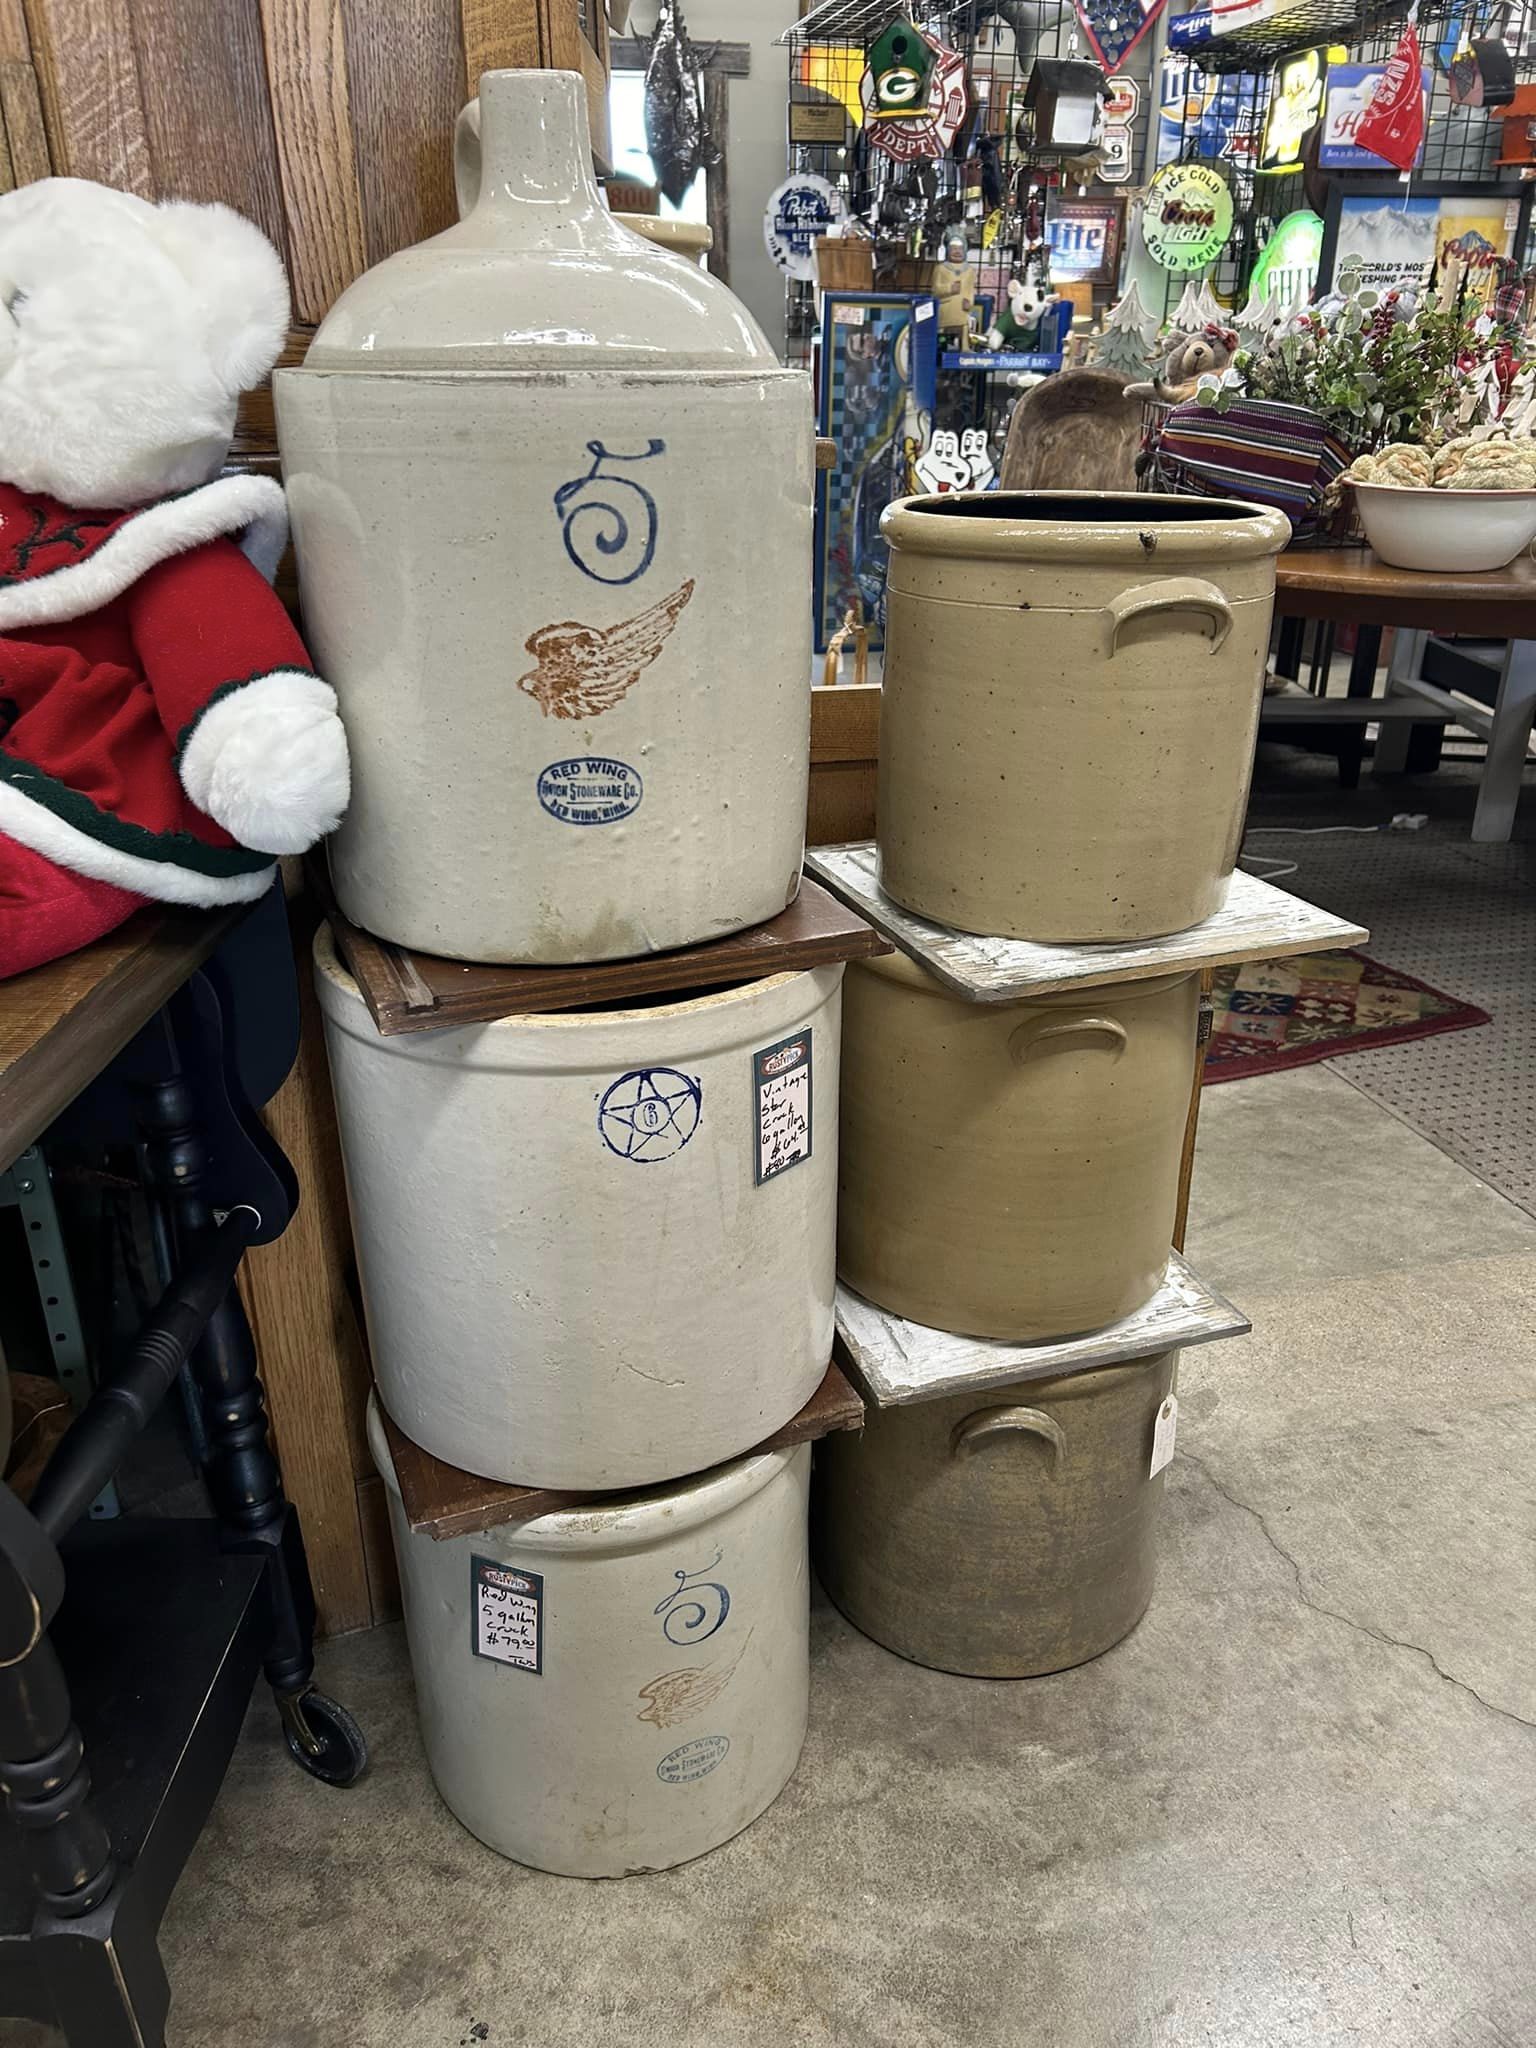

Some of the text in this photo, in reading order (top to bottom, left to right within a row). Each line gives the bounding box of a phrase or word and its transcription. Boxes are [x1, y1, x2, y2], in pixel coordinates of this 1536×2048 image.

[883, 130, 928, 154] DEPT
[1111, 144, 1124, 159] 9
[1165, 170, 1221, 194] ICE COLD
[785, 195, 819, 216] Pabst
[1148, 234, 1222, 266] SOLD HERE
[550, 762, 628, 781] RED WING
[481, 1584, 536, 1616] Red Wing
[482, 1604, 494, 1617] 5
